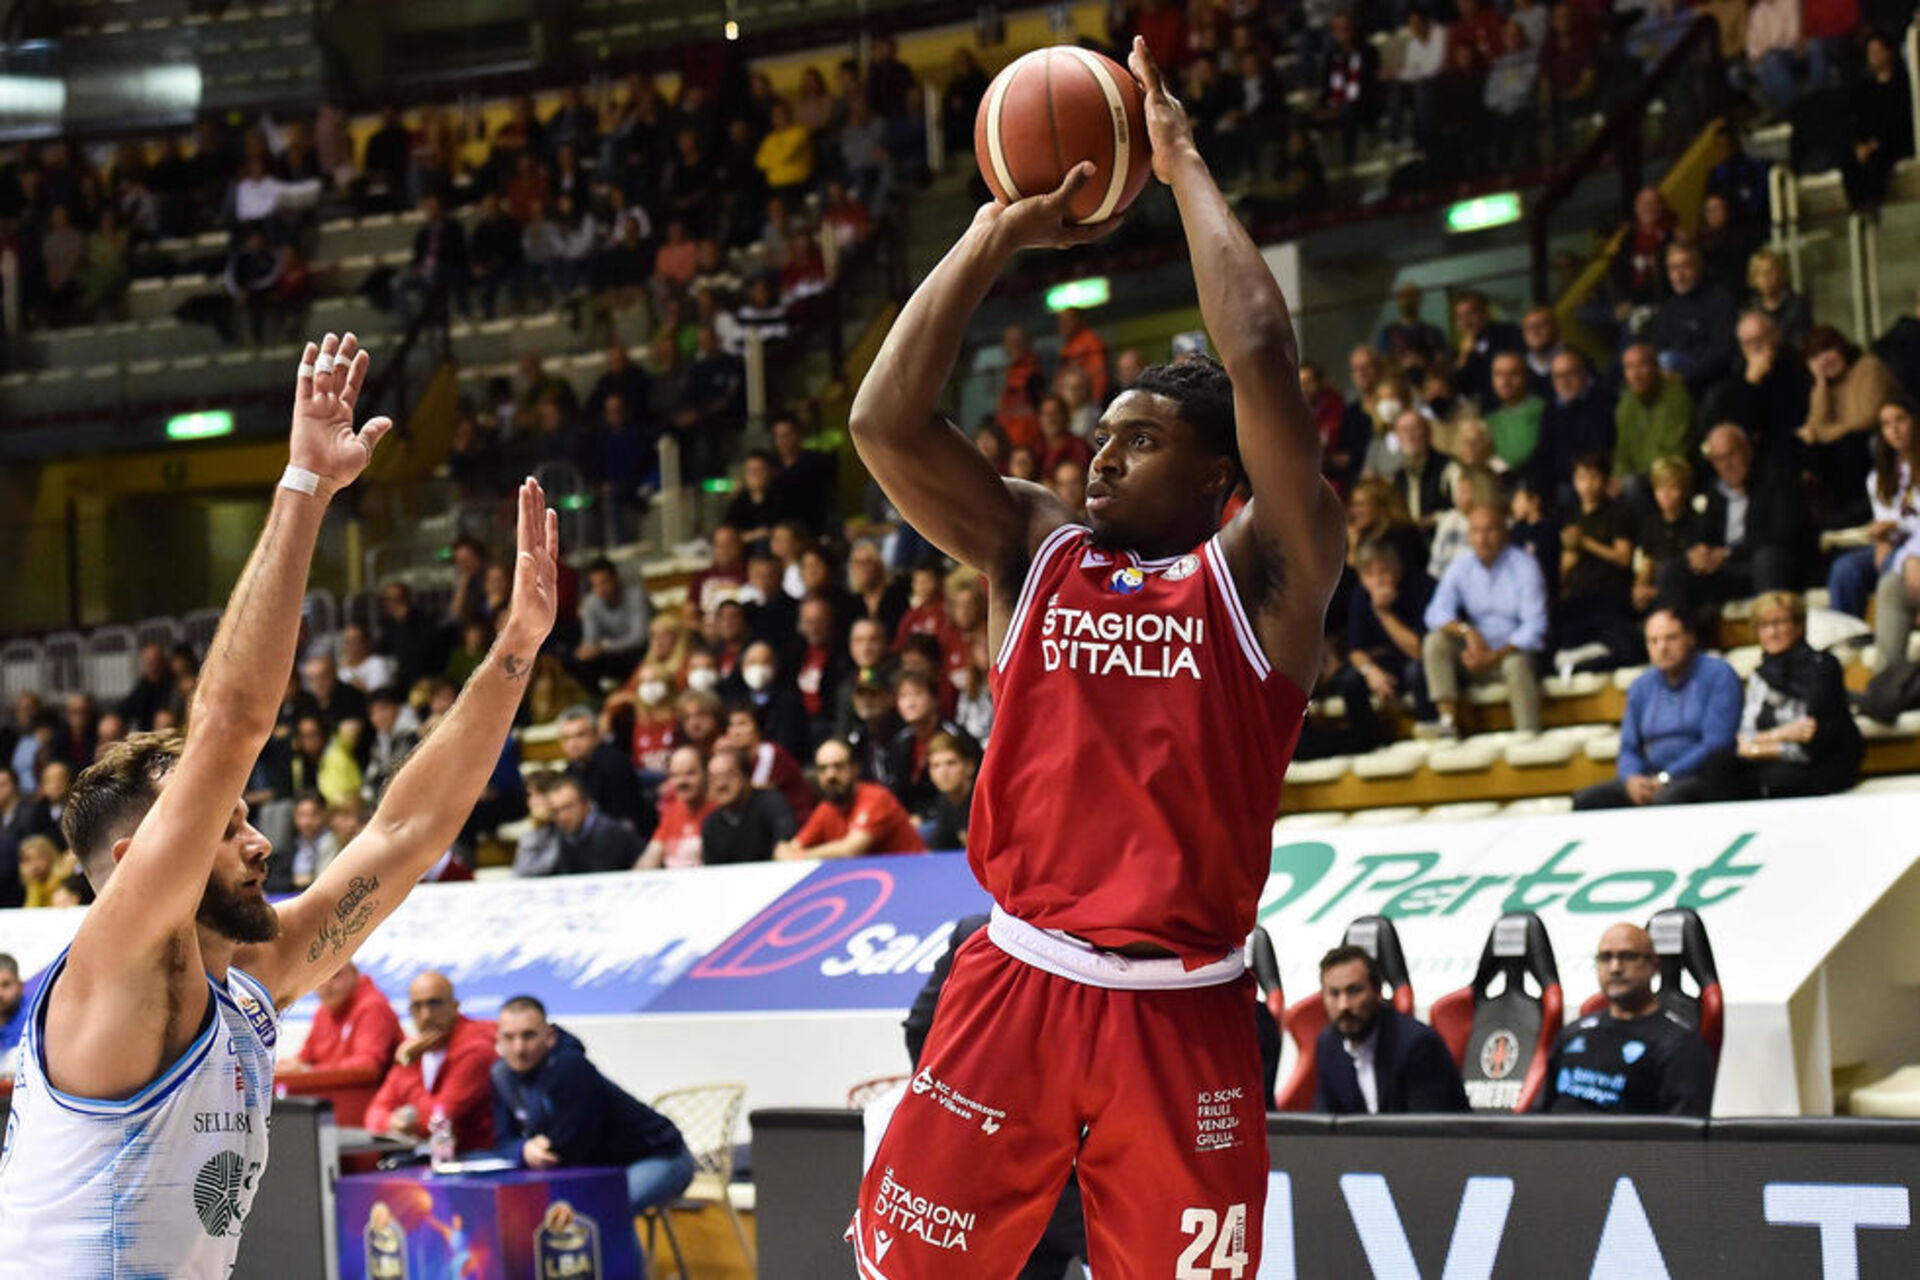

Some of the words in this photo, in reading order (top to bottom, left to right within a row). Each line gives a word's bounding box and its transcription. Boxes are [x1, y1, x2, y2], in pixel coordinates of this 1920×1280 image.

[1042, 607, 1203, 645] STAGIONI
[1042, 638, 1201, 680] D'ITALIA
[1306, 832, 1765, 923] Pertot
[874, 1193, 968, 1252] D'ITALIA
[881, 1175, 976, 1231] STAGIONI
[1176, 1203, 1249, 1280] 24
